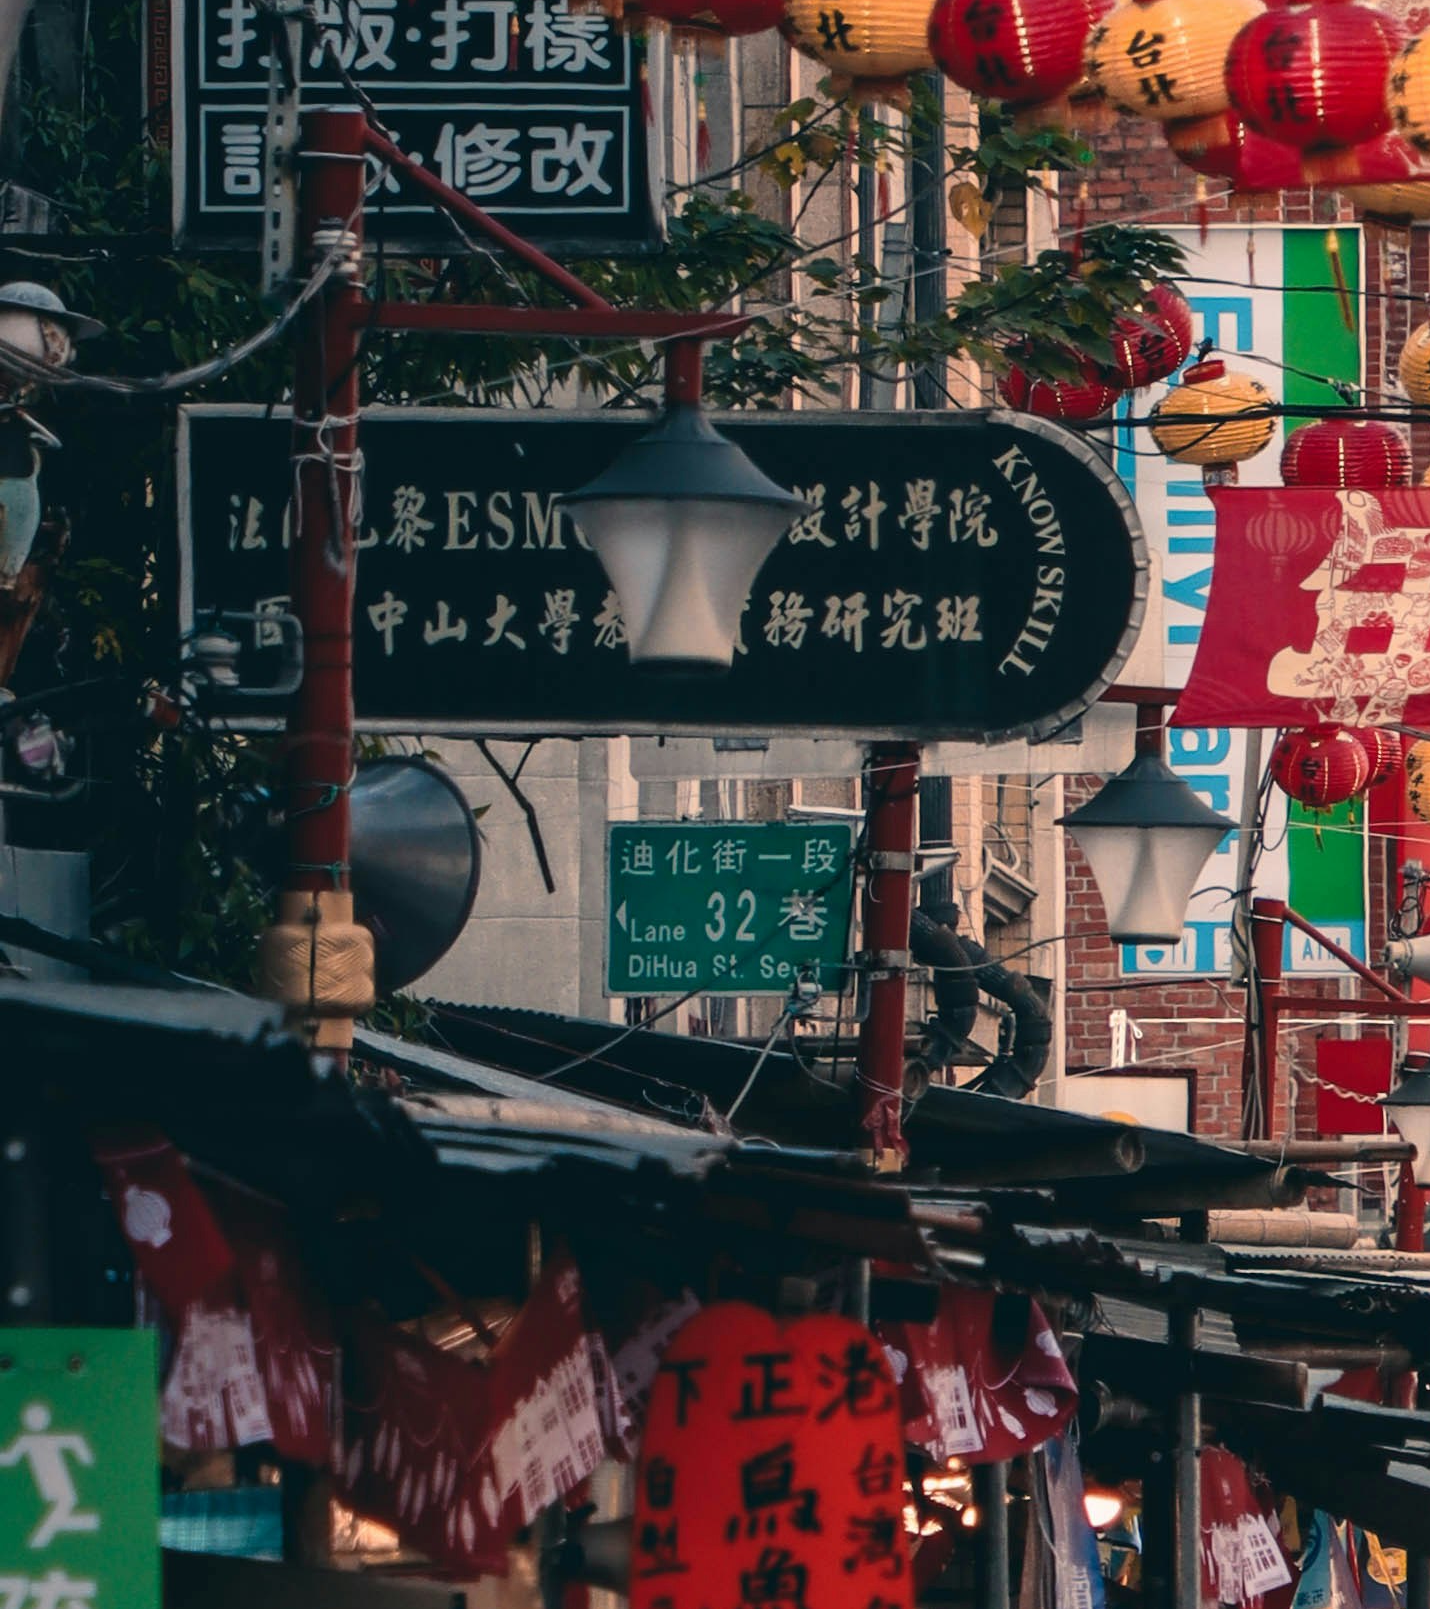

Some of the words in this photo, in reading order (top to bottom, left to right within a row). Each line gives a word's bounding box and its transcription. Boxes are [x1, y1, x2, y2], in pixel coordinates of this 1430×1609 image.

[992, 444, 1066, 558] KNOW
[998, 564, 1066, 677] SKILL
[620, 838, 838, 875] 迪化街一段
[630, 919, 686, 942] Lane
[705, 889, 757, 942] 32
[628, 954, 697, 979] DiHua
[713, 954, 745, 979] St.
